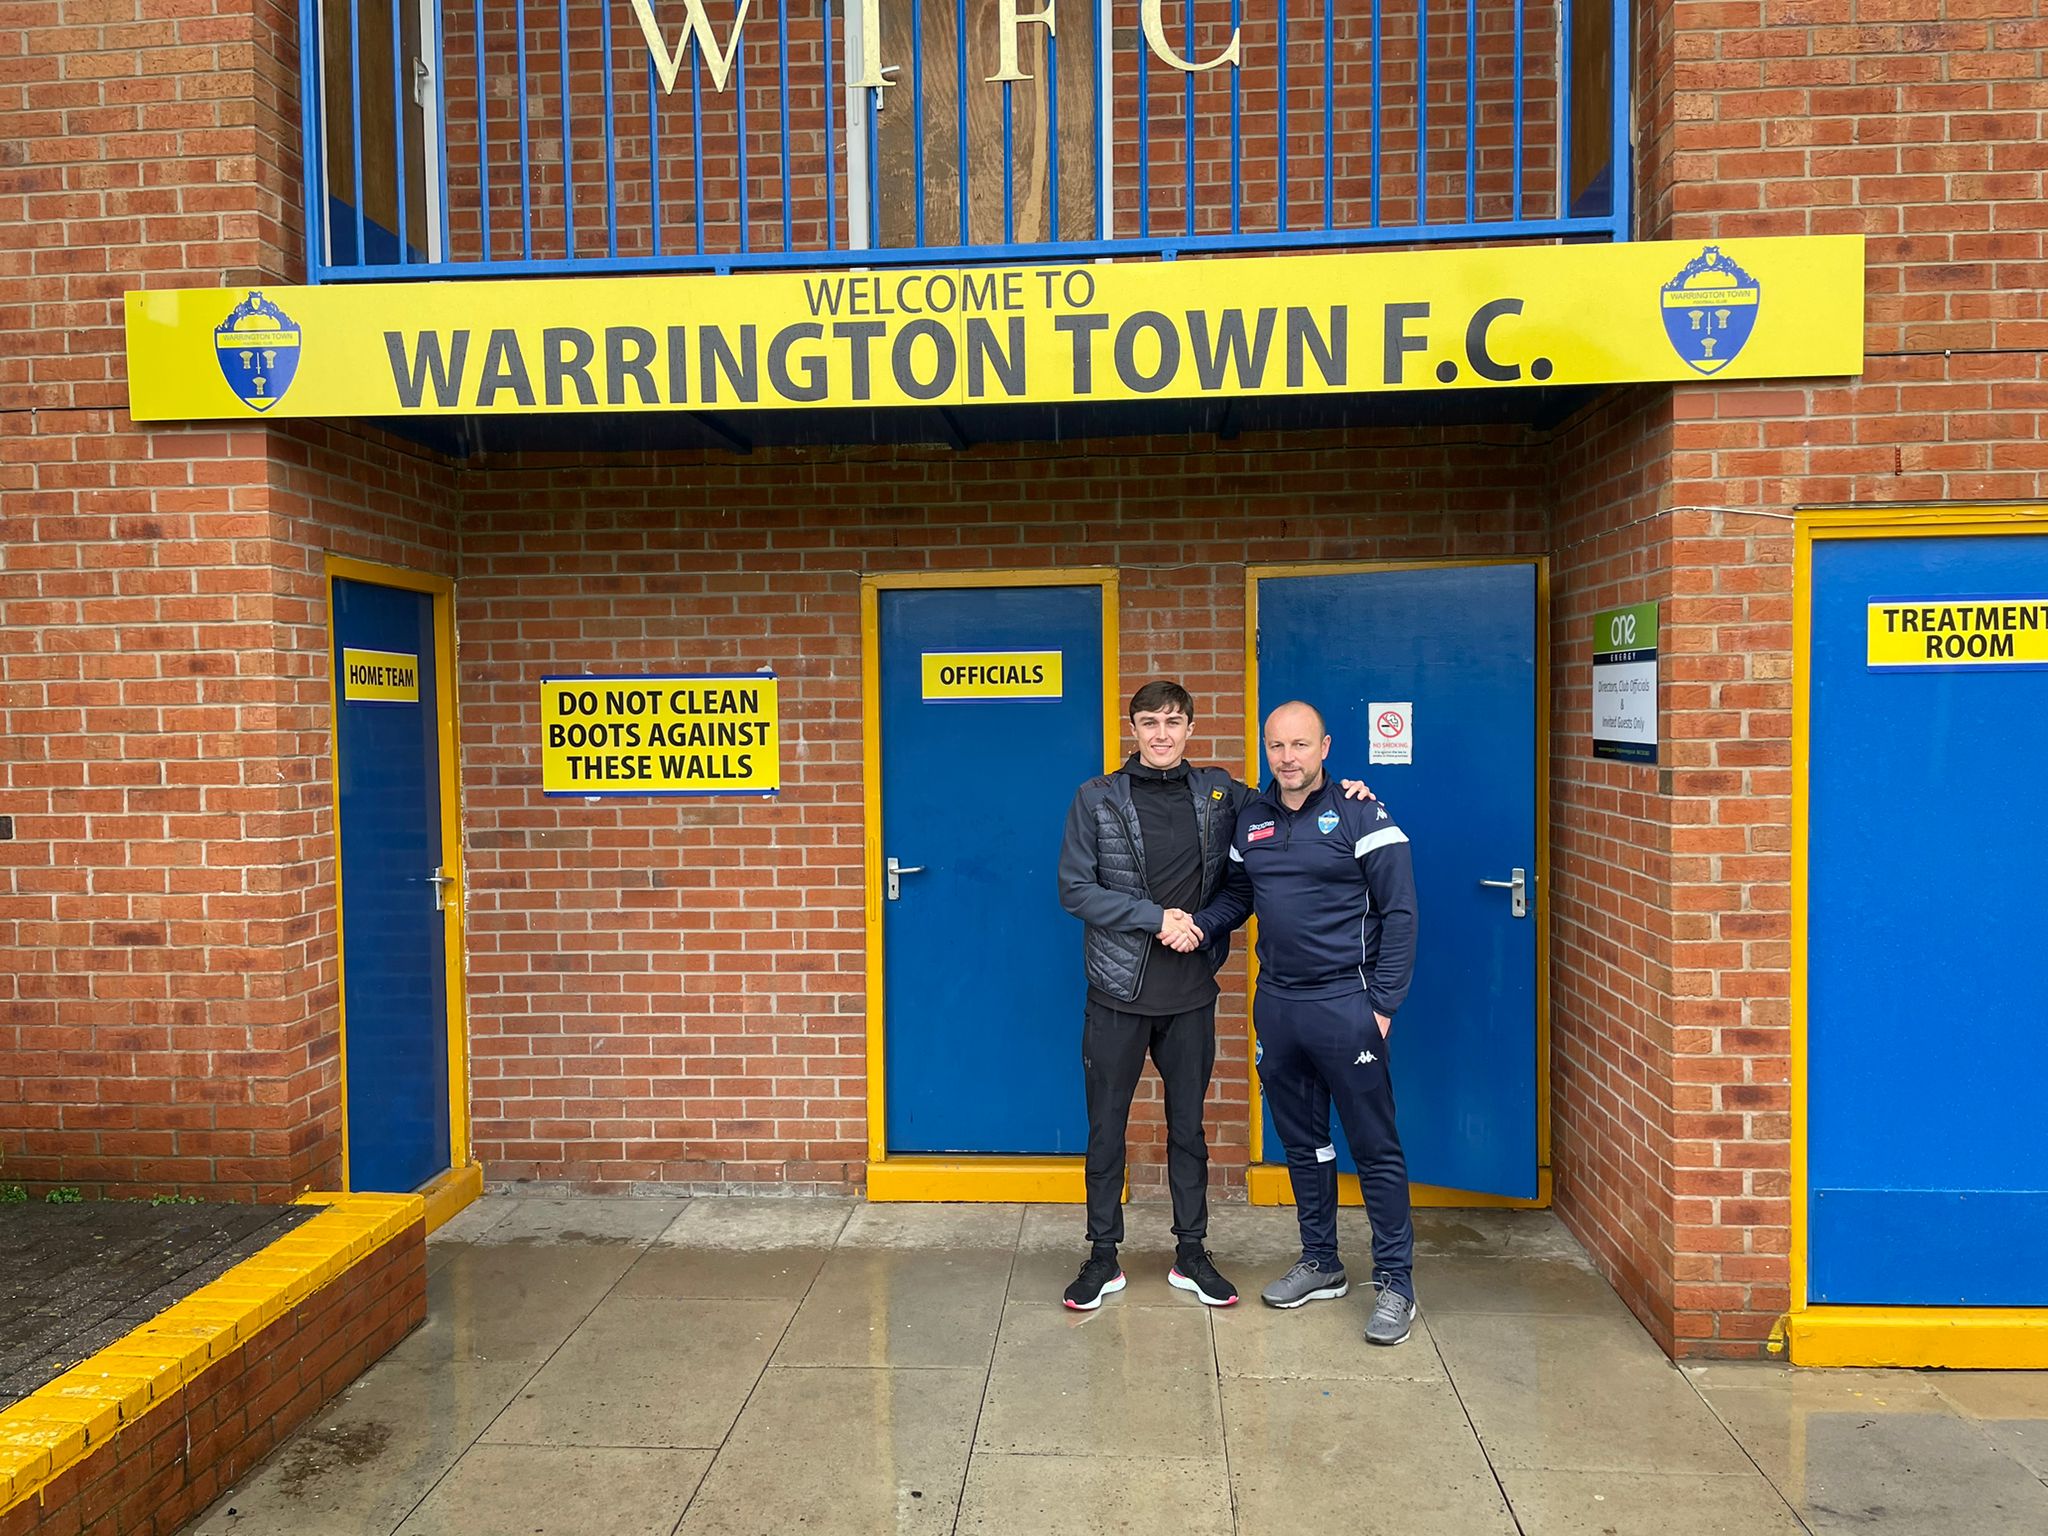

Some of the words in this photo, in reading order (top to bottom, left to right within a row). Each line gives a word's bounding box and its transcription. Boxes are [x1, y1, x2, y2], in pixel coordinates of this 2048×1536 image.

[804, 272, 1023, 315] WELCOME
[1036, 269, 1094, 308] TO
[1670, 291, 1725, 300] WARRINGTON
[1727, 290, 1751, 298] TOWN
[222, 333, 271, 341] WARRINGTON
[383, 316, 1026, 408] WARRINGTON
[1055, 304, 1347, 395] TOWN
[1383, 298, 1553, 385] F.C.
[1610, 613, 1636, 646] one
[1610, 652, 1637, 662] ENERGY
[1926, 633, 2014, 658] ROOM
[349, 664, 384, 687] HOME
[385, 667, 415, 687] TEAM
[940, 665, 1044, 685] OFFICIALS
[1598, 680, 1618, 693] Directors,
[1618, 680, 1629, 692] Club
[1630, 678, 1650, 694] Officials
[558, 691, 598, 716] DO
[605, 690, 663, 715] NOT
[669, 689, 758, 715] CLEAN
[549, 723, 641, 748] BOOTS
[647, 721, 771, 748] AGAINST
[1602, 716, 1617, 728] Invited
[1617, 716, 1633, 729] Guests
[1633, 717, 1645, 732] Only
[566, 755, 652, 780] THESE
[658, 754, 753, 779] WALLS
